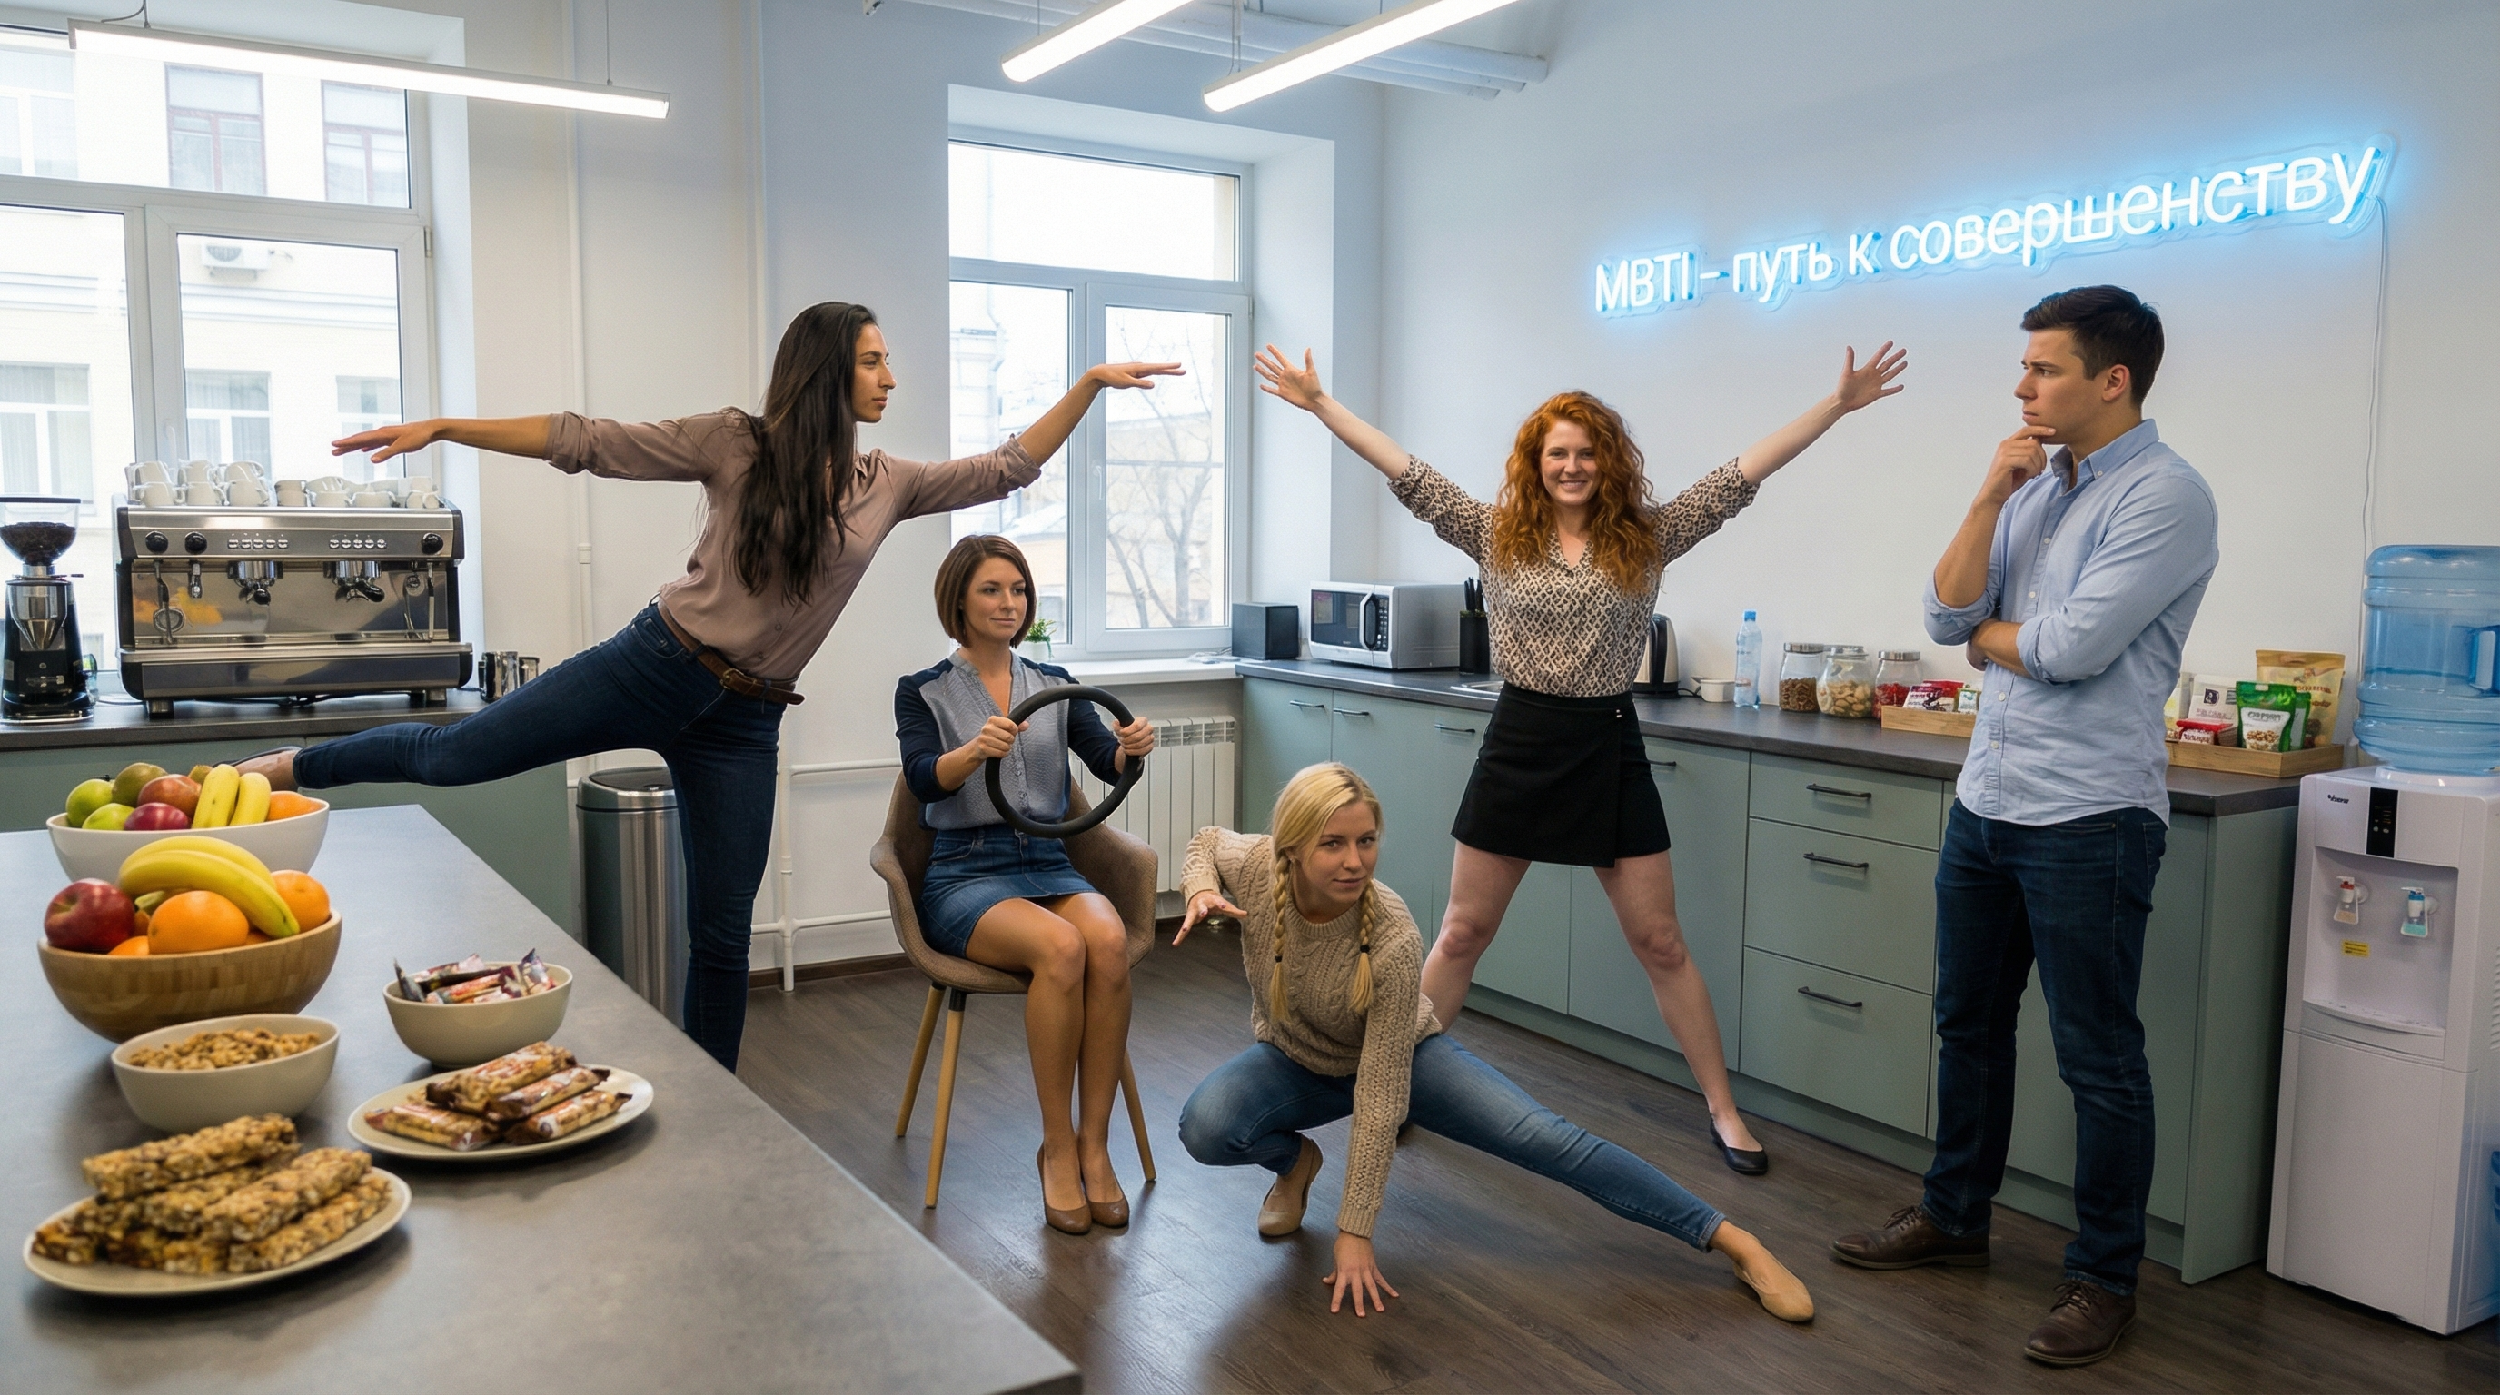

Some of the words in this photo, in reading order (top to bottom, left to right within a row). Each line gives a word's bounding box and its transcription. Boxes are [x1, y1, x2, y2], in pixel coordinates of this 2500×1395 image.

[1595, 251, 1694, 312] MBTI
[1732, 242, 1833, 303] путь
[1850, 231, 1881, 276] к
[1889, 146, 2380, 267] совершенству
